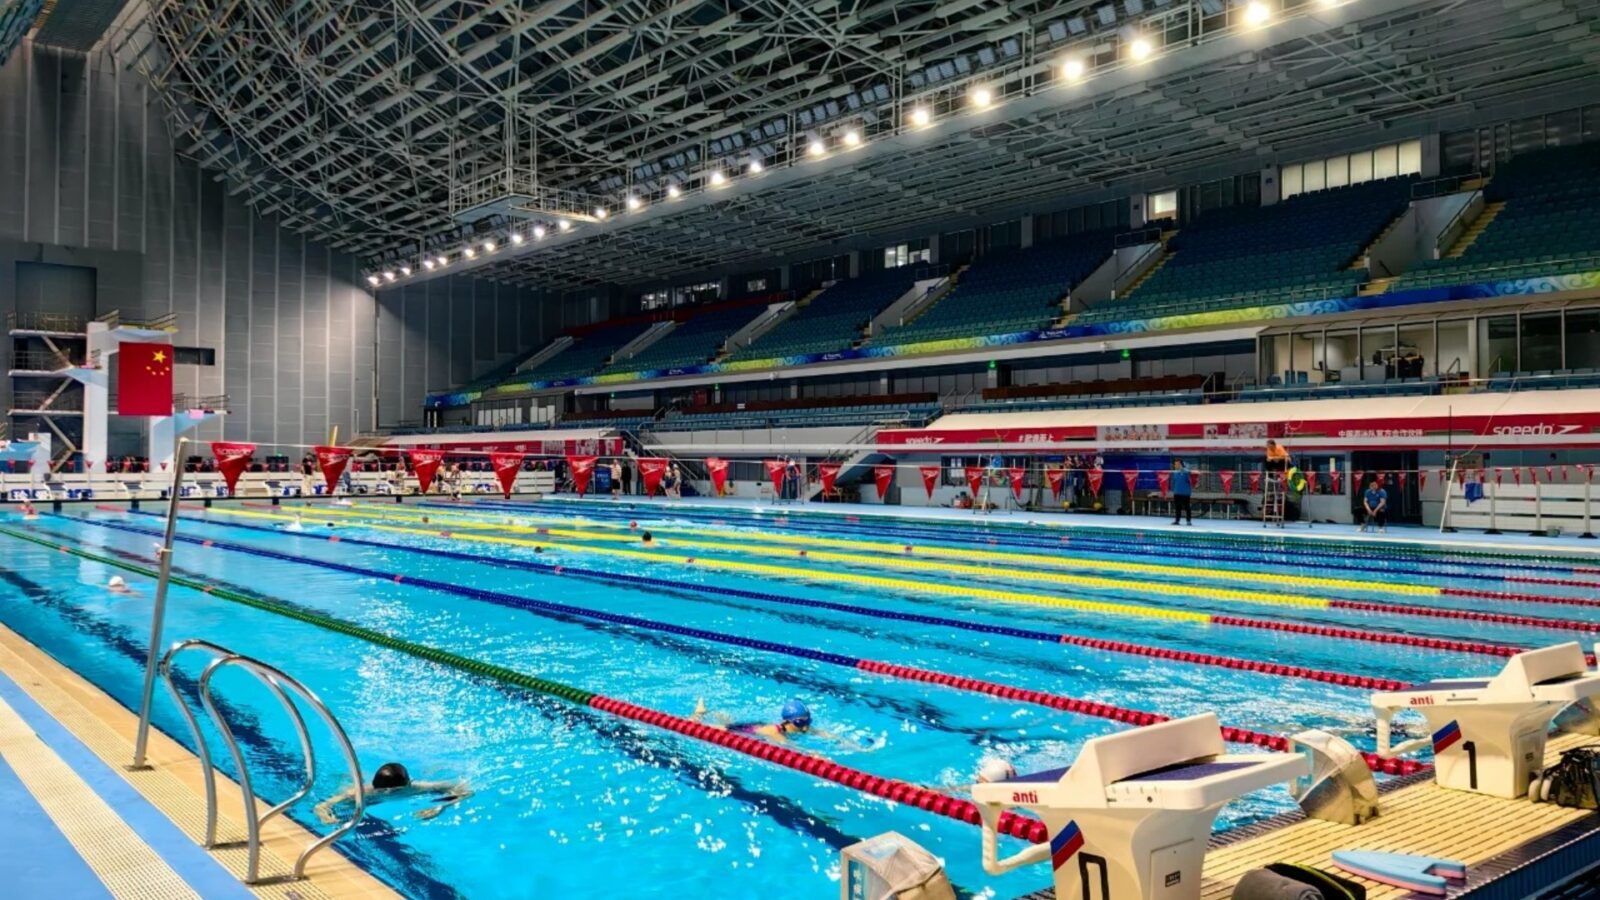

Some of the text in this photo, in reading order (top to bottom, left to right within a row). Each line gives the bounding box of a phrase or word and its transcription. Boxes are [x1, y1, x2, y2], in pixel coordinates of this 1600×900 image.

[1493, 423, 1553, 435] speedo
[1409, 695, 1434, 705] anti
[1462, 740, 1478, 789] 1
[1012, 790, 1039, 804] anti
